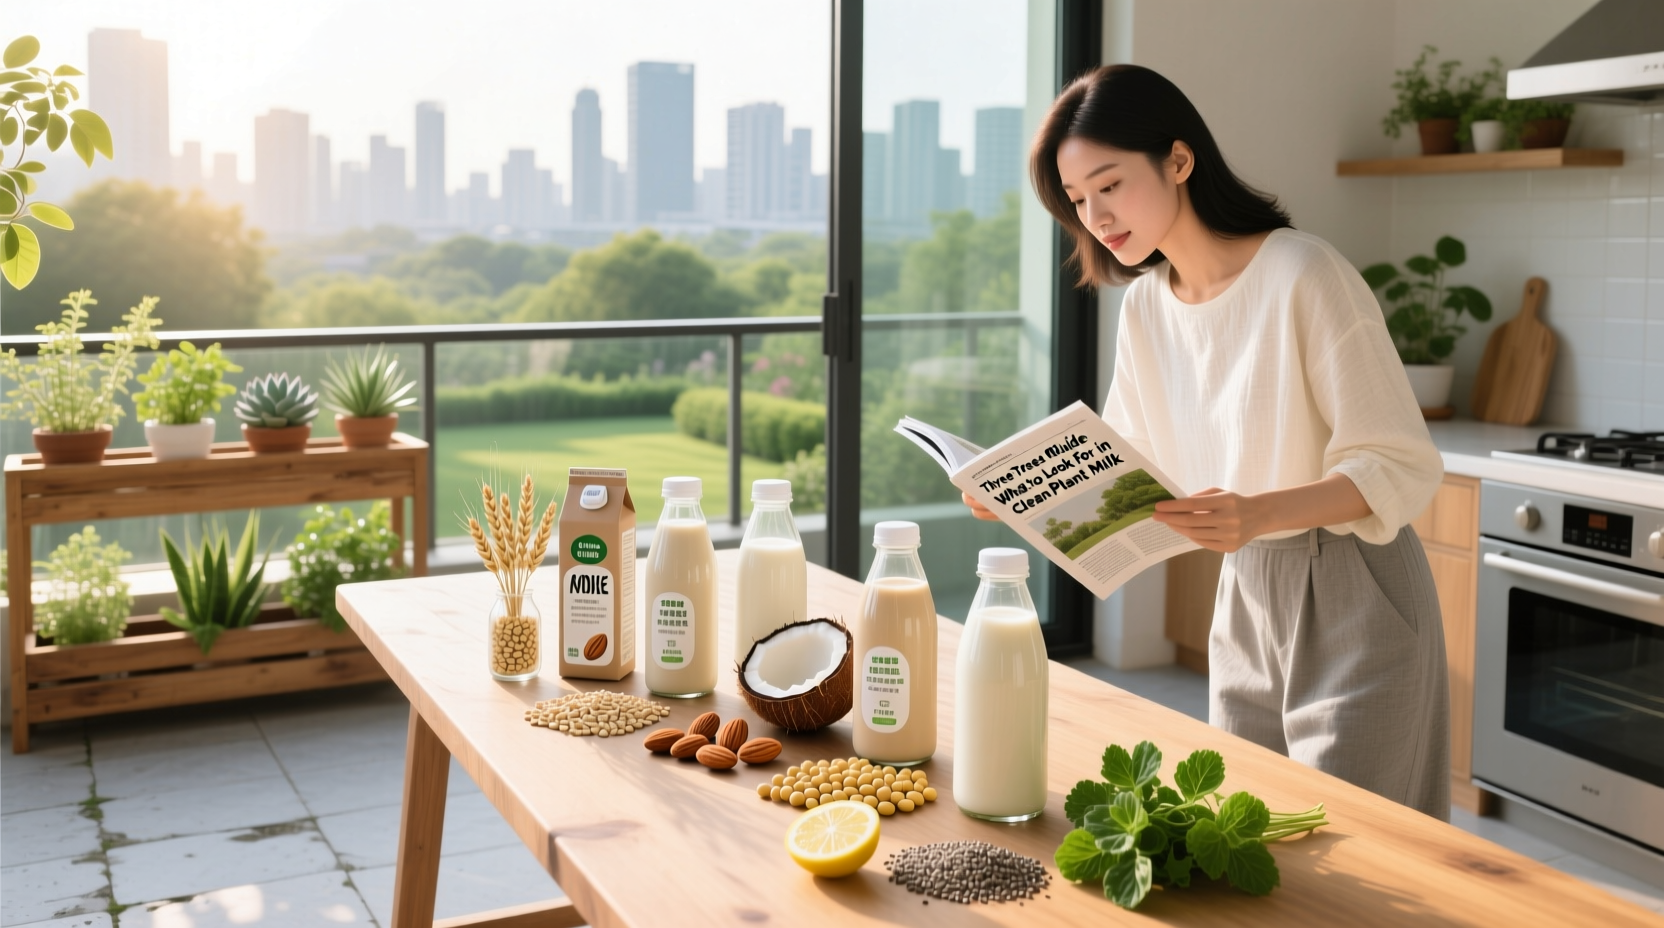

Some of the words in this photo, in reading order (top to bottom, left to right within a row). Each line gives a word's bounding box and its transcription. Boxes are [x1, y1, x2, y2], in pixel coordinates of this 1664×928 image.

[1041, 458, 1075, 479] Look
[1073, 448, 1094, 464] For
[1094, 440, 1112, 453] in
[1012, 489, 1052, 514] Clean
[1048, 469, 1090, 496] Plant
